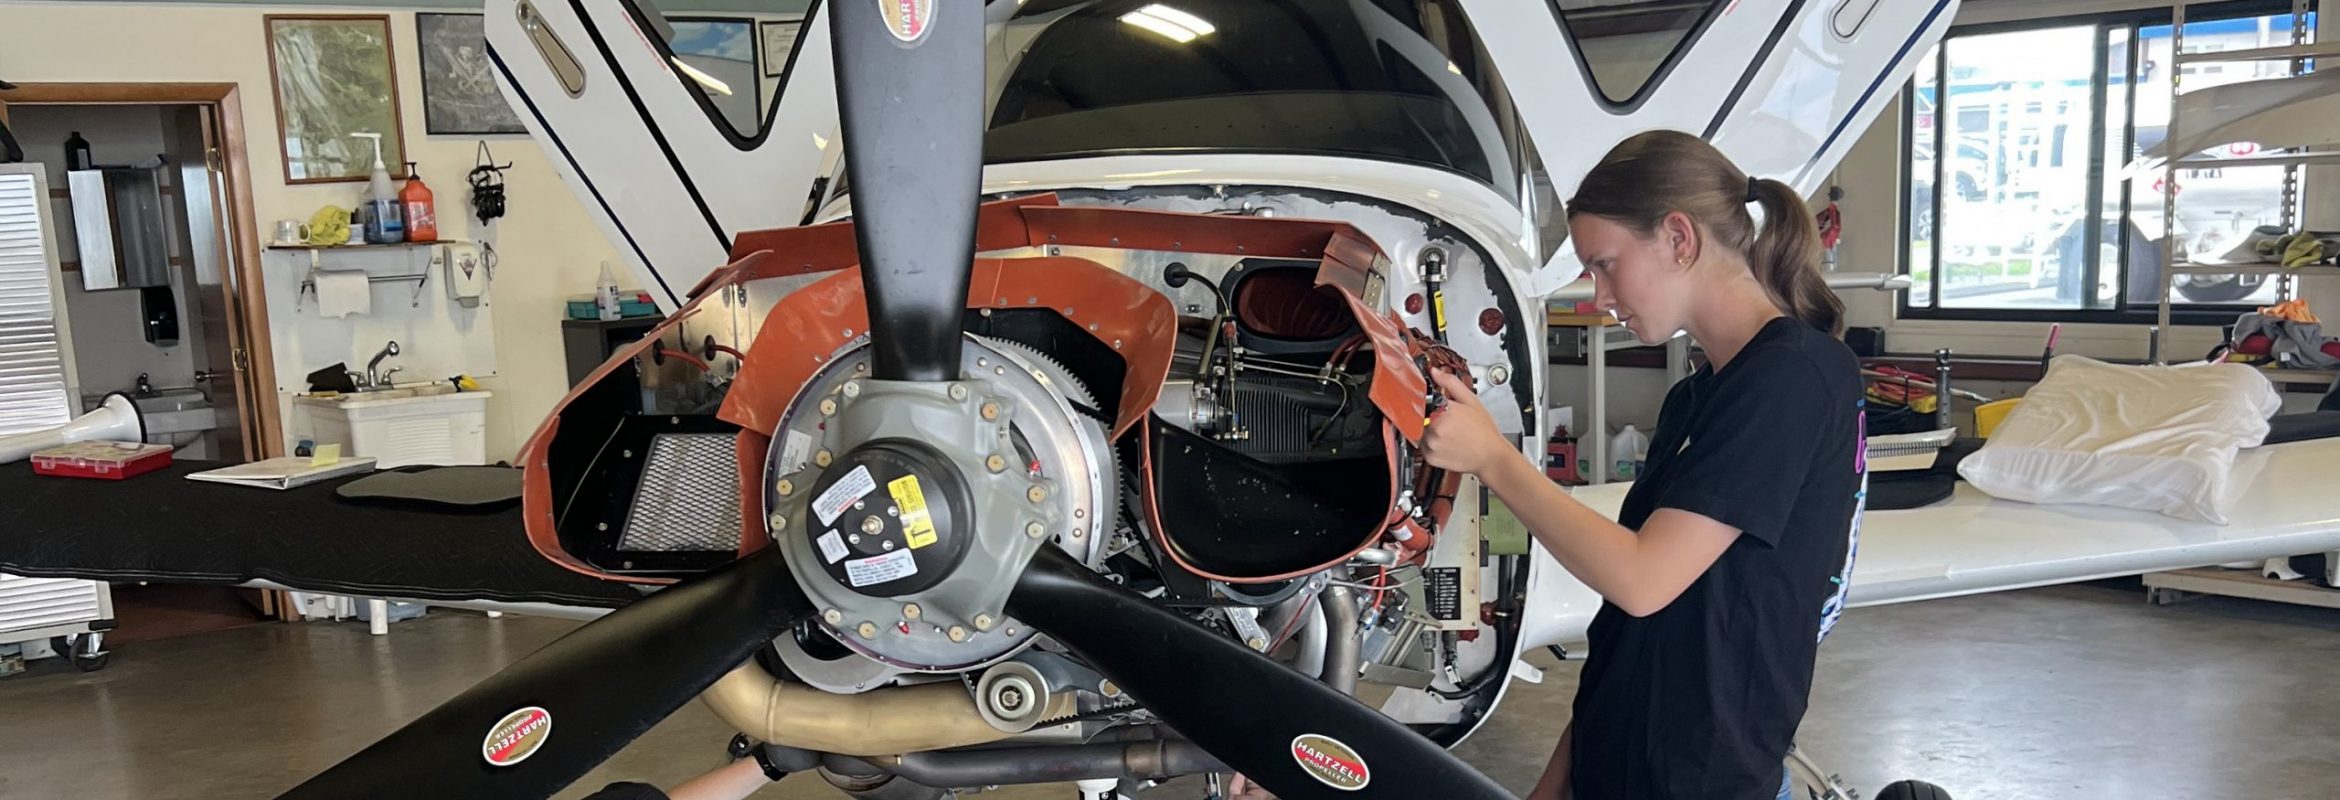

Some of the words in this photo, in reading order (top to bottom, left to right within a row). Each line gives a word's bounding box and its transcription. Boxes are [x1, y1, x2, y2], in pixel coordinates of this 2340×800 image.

[901, 0, 912, 34] HAR
[487, 715, 547, 754] HARTZELL
[495, 714, 533, 739] PROPELLER
[1296, 741, 1362, 783] HARTZELL
[1304, 756, 1347, 784] PROPELLER
